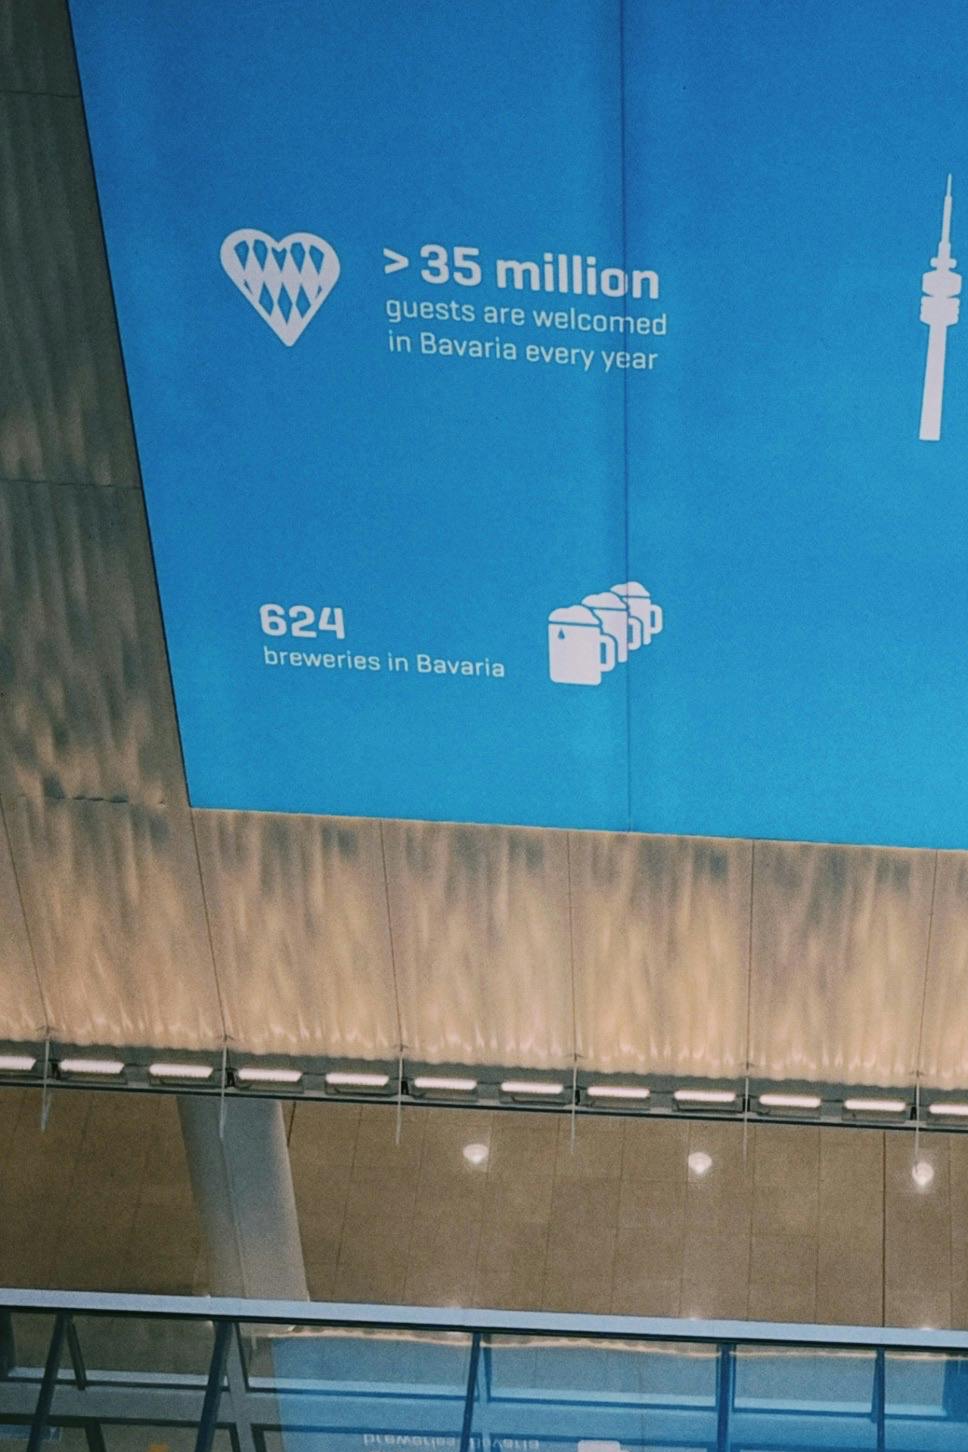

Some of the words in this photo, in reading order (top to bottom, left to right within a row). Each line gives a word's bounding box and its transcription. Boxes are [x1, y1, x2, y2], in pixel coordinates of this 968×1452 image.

[419, 244, 483, 287] 35
[496, 252, 660, 300] million
[385, 299, 476, 323] guests
[483, 305, 526, 326] are
[532, 307, 668, 336] welcomed
[388, 329, 412, 353] in
[419, 331, 518, 361] Bavaria
[525, 345, 595, 372] every
[601, 349, 659, 373] year
[259, 603, 346, 640] 624
[263, 645, 381, 672] breweries
[387, 651, 409, 673] in
[415, 653, 506, 678] Bavaria
